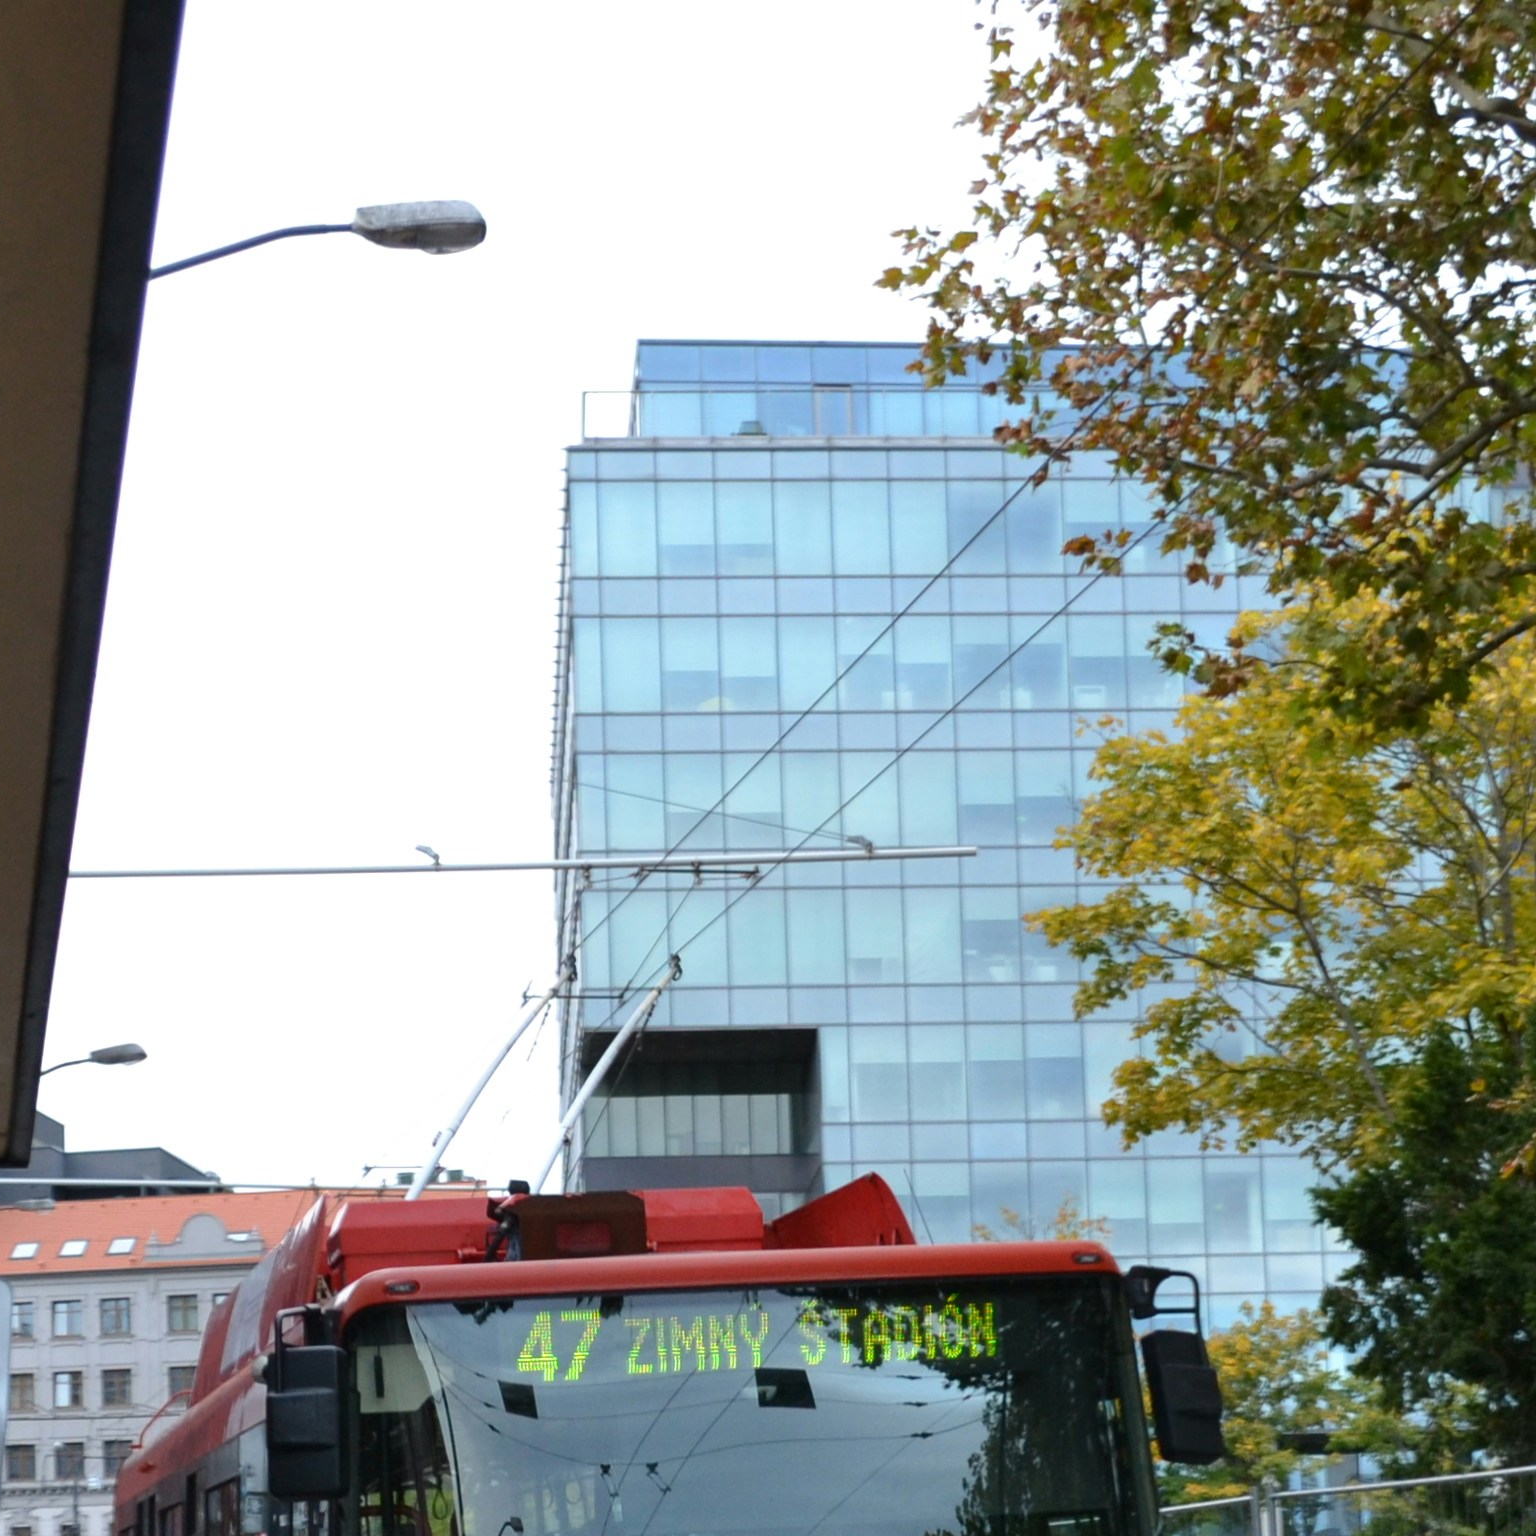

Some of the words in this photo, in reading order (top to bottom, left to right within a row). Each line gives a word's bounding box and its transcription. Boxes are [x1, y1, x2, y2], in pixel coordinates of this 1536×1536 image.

[517, 1310, 601, 1382] 47
[624, 1302, 768, 1375] ZIMNÝ
[799, 1293, 997, 1366] ŠTADIÓN
